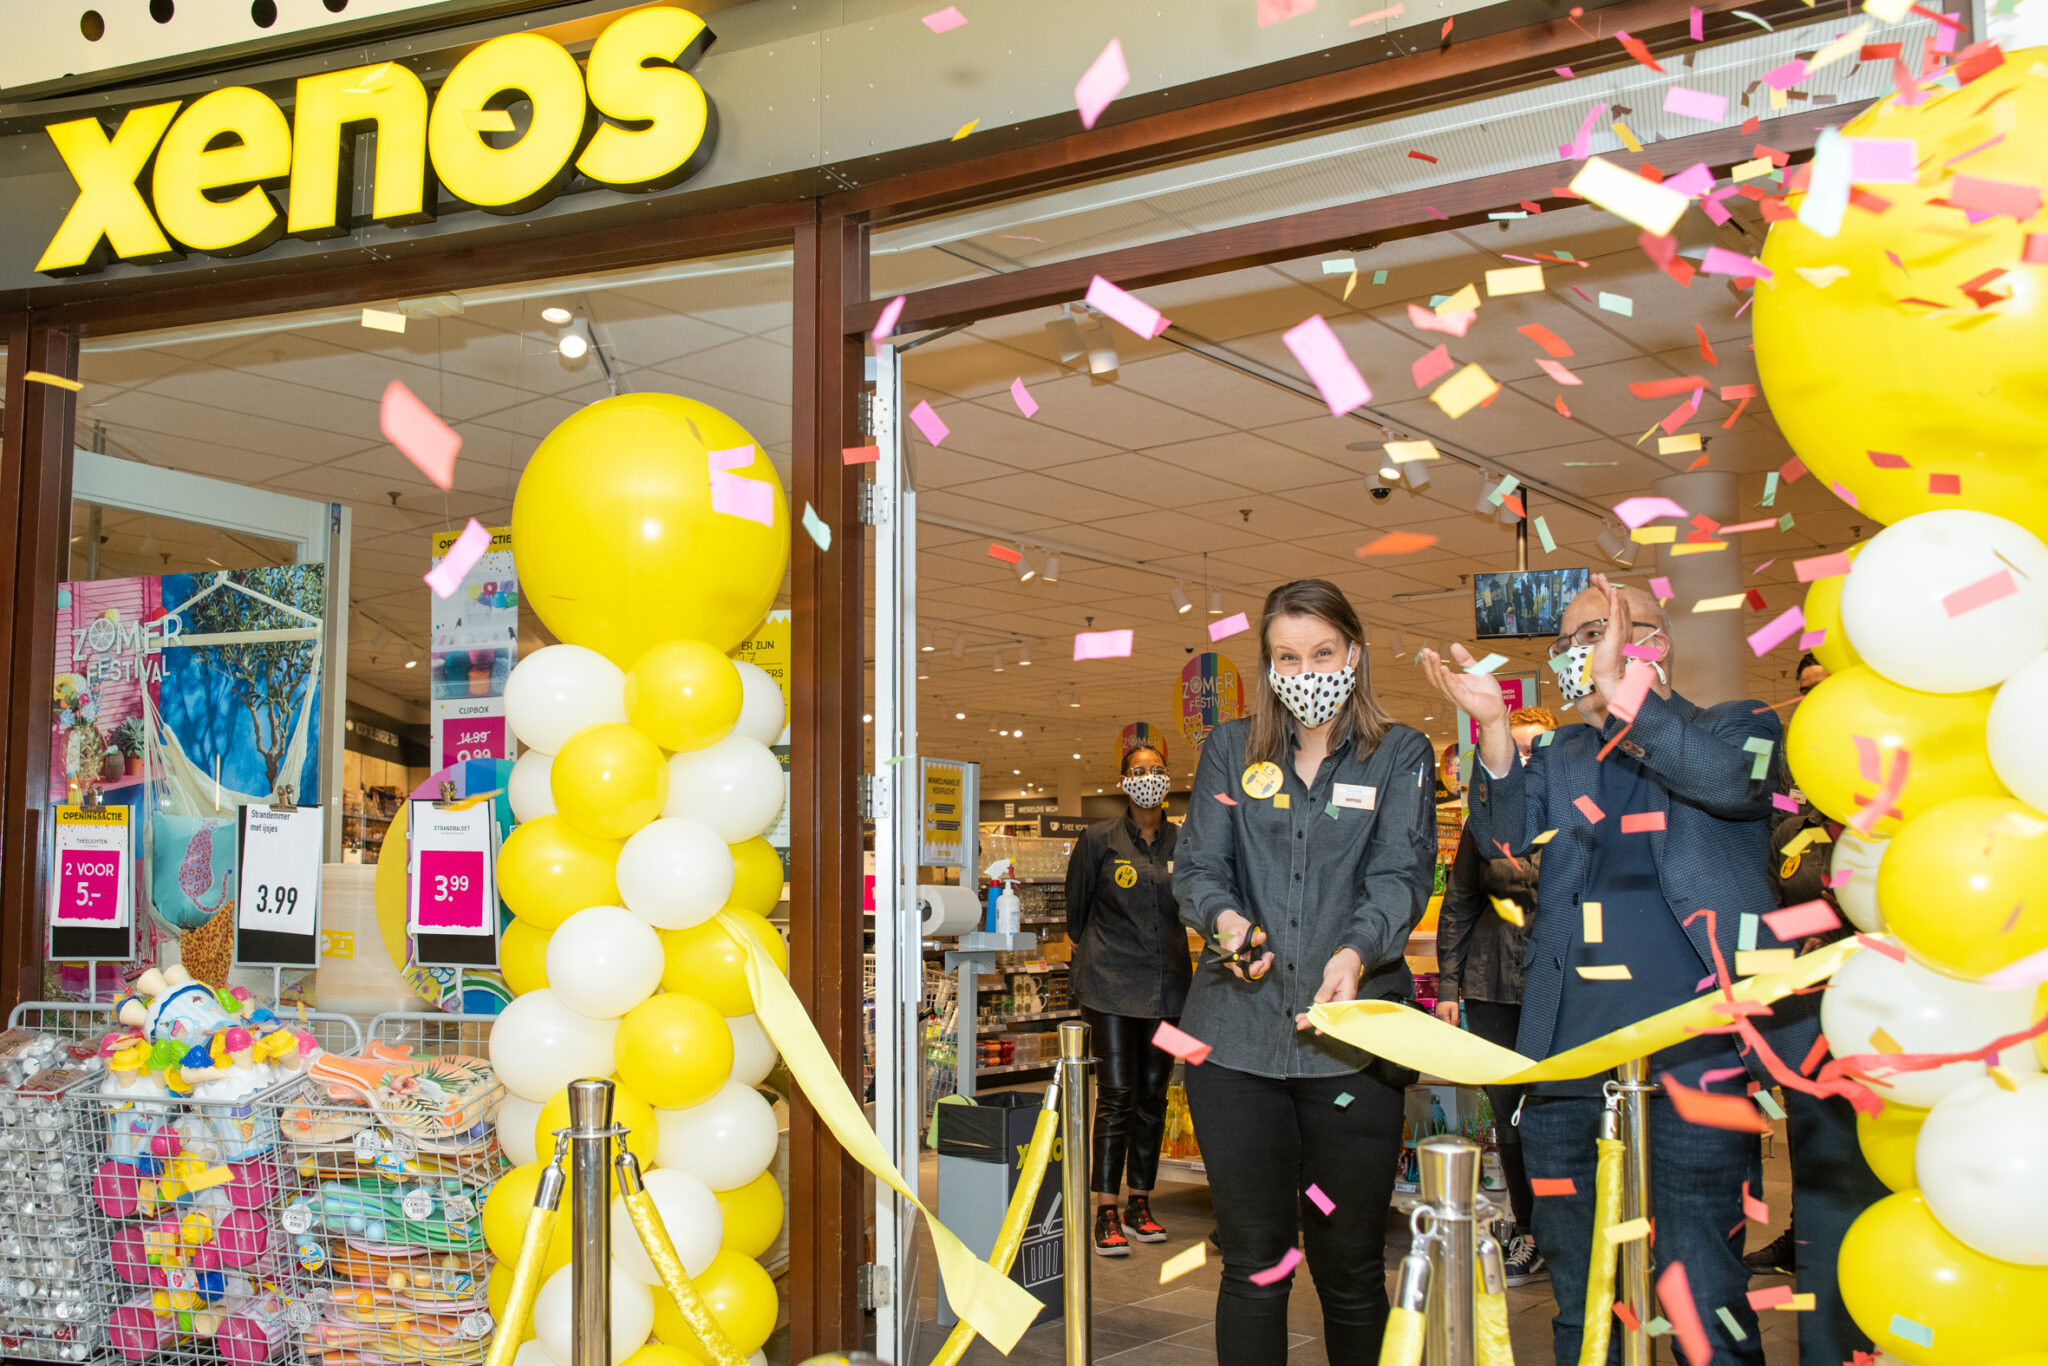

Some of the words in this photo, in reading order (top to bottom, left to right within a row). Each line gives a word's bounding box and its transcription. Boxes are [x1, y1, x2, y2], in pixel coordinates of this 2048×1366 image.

[34, 6, 712, 273] xenos
[72, 614, 183, 662] ZOMER
[741, 641, 753, 650] ER
[756, 640, 775, 650] ZIJN
[86, 655, 171, 685] FESTIVAL
[1182, 671, 1234, 699] ZOMER
[458, 706, 489, 715] CLIPBOX
[1189, 694, 1229, 712] FESTIVAL
[457, 730, 490, 745] 14.99
[62, 811, 123, 821] OPENINGSACTIE
[251, 809, 291, 821] Strandemmer
[250, 823, 262, 832] met
[262, 824, 278, 834] ijsjes
[65, 862, 73, 876] 2
[76, 862, 115, 877] VOOR
[434, 874, 470, 902] 3.99
[256, 884, 299, 916] 3.99
